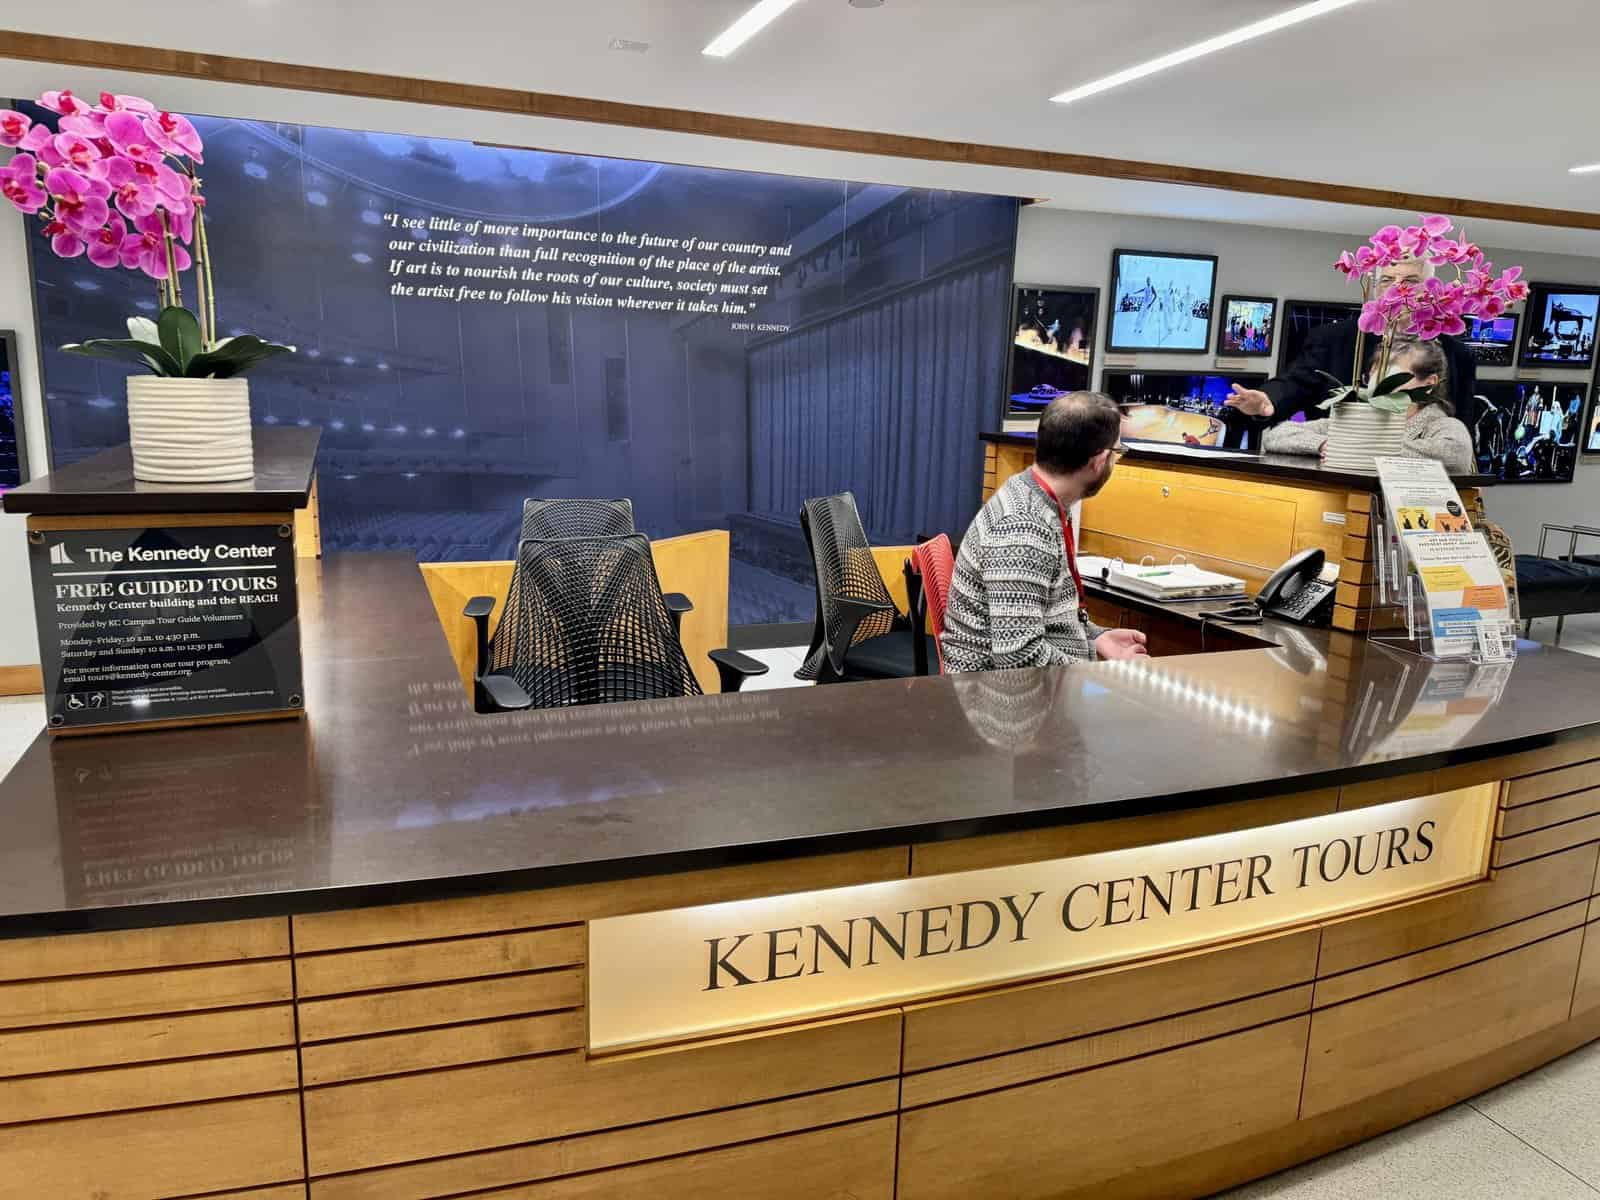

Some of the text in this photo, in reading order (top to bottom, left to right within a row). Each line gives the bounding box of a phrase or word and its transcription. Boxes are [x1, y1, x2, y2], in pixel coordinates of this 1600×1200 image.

[402, 217, 425, 229] see
[429, 216, 461, 231] little
[464, 220, 482, 236] of
[483, 224, 519, 236] more
[522, 224, 598, 241] importance
[601, 232, 613, 243] to
[616, 231, 637, 245] the
[637, 233, 679, 248] future
[682, 237, 697, 252] of
[697, 241, 719, 251] our
[721, 242, 767, 257] country
[769, 244, 792, 257] and
[388, 239, 781, 276] our civilization than full recognition of the place of the artist.
[388, 259, 768, 296] If art is to nourish the roots of our culture, society must set
[390, 282, 414, 296] the
[417, 284, 455, 298] artist
[455, 285, 486, 302] free
[489, 289, 503, 301] to
[503, 288, 549, 305] follow
[551, 291, 572, 305] his
[575, 293, 613, 308] vision
[617, 296, 674, 310] wherever
[676, 298, 686, 312] it
[688, 300, 719, 313] takes
[757, 323, 791, 333] KENNEDY
[85, 544, 276, 563] The Kennedy Center
[55, 575, 278, 599] FREE GUIDED TOURS
[56, 594, 279, 613] Kennedy Center building and the REACH
[57, 620, 95, 629] Provided
[96, 620, 107, 629] by
[122, 618, 156, 627] Campus
[177, 615, 200, 623] Guide
[202, 614, 243, 622] Volunteers
[60, 649, 96, 658] Saturday
[99, 647, 114, 656] and
[63, 667, 76, 675] For
[102, 664, 149, 672] information
[63, 674, 86, 682] email
[701, 820, 1437, 992] KENNEDY CENTER TOURS
